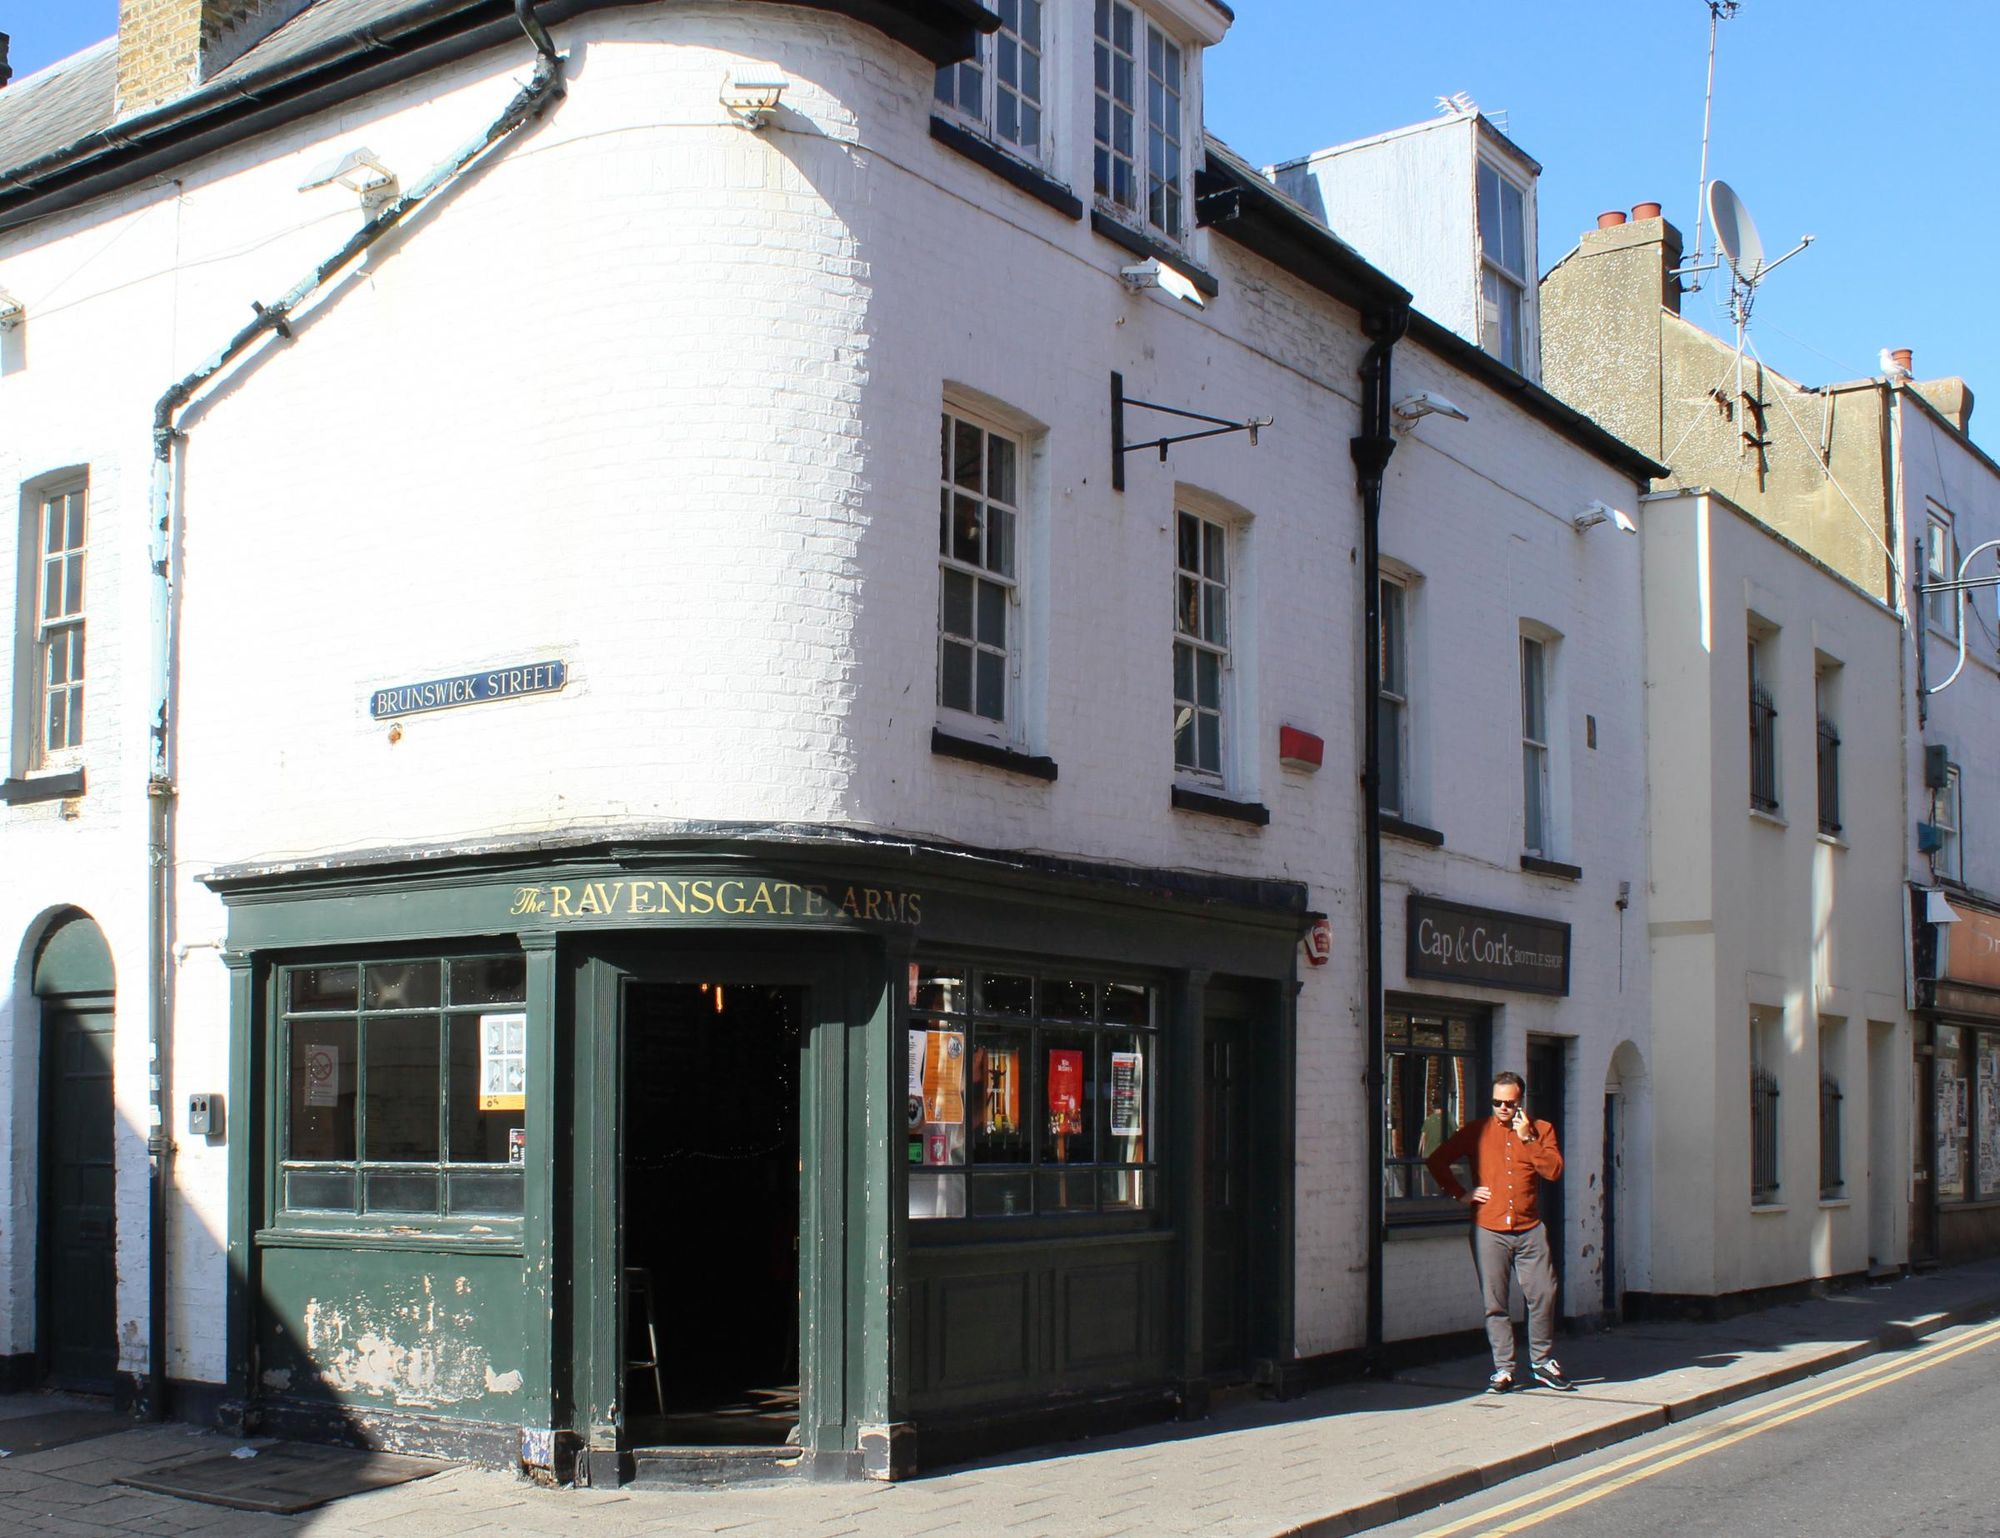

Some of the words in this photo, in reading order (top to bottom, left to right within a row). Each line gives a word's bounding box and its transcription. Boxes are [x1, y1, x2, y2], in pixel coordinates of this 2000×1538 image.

[377, 678, 476, 714] BRUNSWICK
[487, 664, 556, 696] STREET
[510, 887, 545, 916] The
[550, 880, 829, 918] RAVENSGATE
[834, 885, 922, 926] ARMS
[1418, 918, 1453, 965] Cap
[1455, 926, 1470, 964] &
[1472, 927, 1514, 966] Cork
[1514, 949, 1544, 967] BOTTLE
